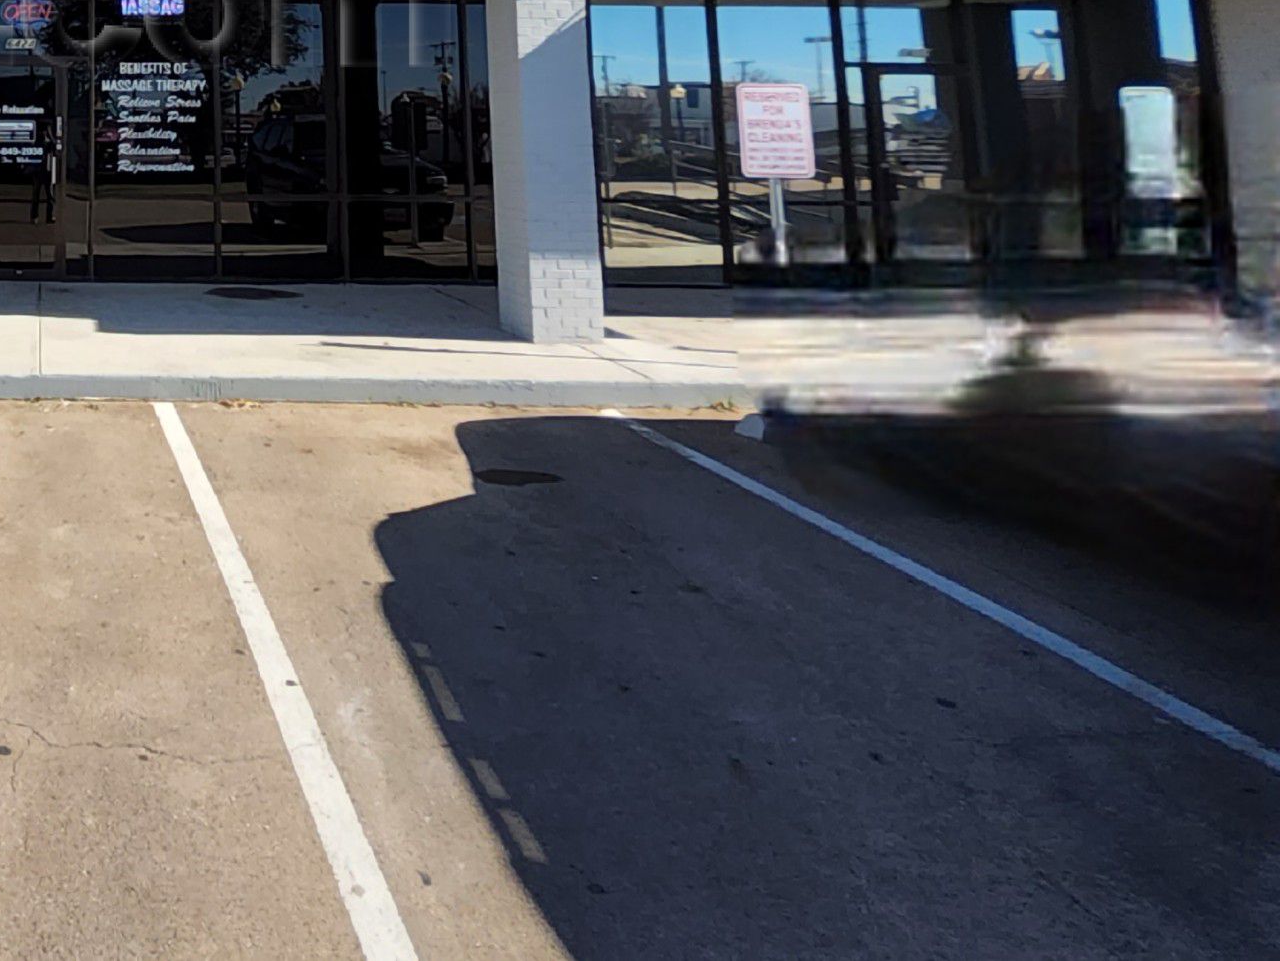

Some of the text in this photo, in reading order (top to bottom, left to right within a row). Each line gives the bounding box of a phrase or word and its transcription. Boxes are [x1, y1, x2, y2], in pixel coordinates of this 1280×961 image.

[3, 3, 52, 20] OPEN
[119, 62, 188, 74] BENEFITS OF
[101, 80, 206, 91] MASSAGE THERAPY
[167, 111, 197, 123] Pain
